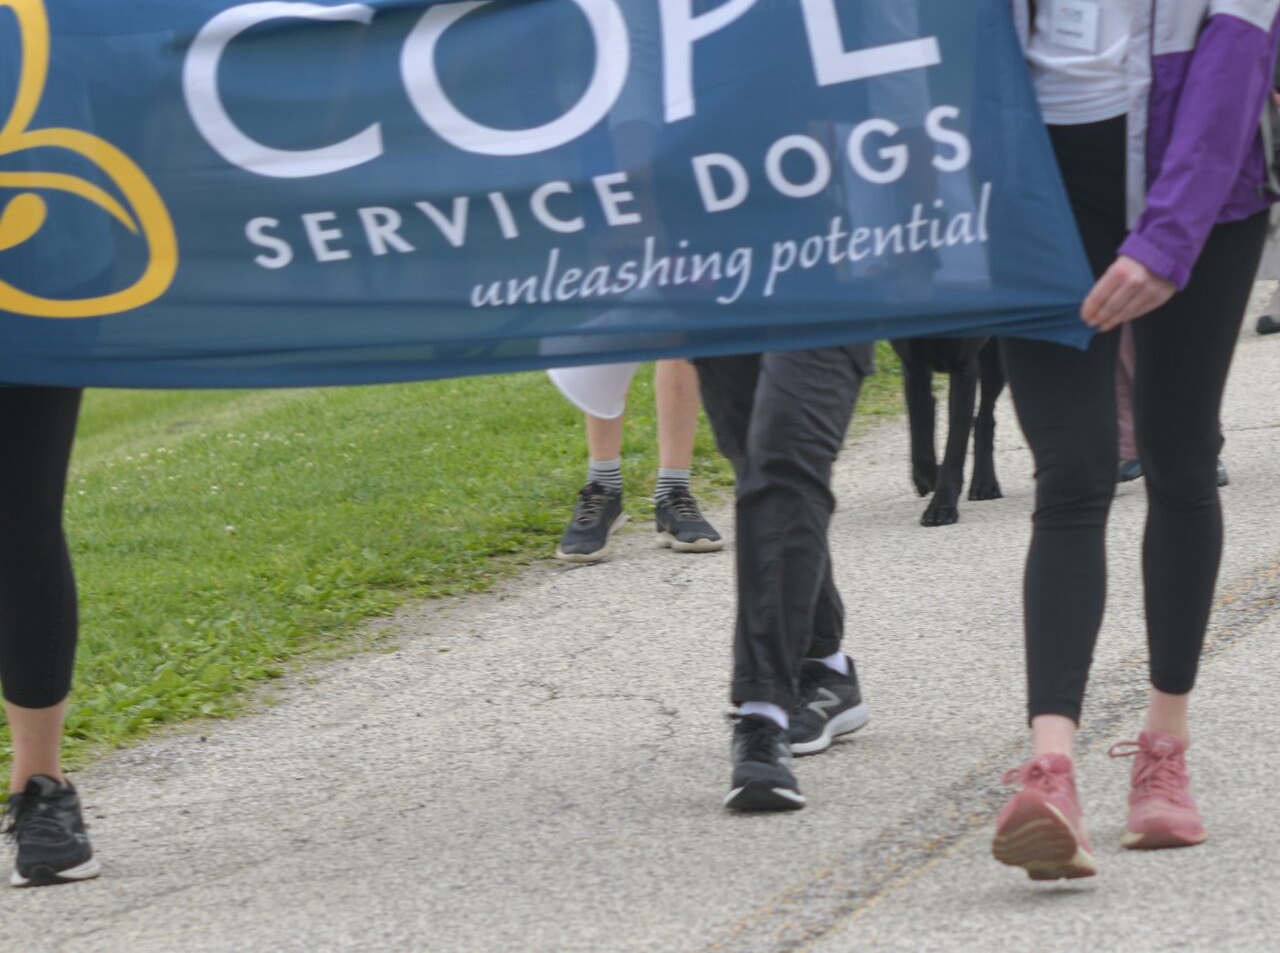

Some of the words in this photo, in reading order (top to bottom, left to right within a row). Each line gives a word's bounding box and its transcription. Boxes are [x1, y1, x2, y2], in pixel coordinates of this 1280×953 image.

[244, 171, 642, 270] SERVICE
[692, 104, 972, 214] DOGS
[469, 236, 753, 305] unleashing
[763, 181, 993, 297] potential
